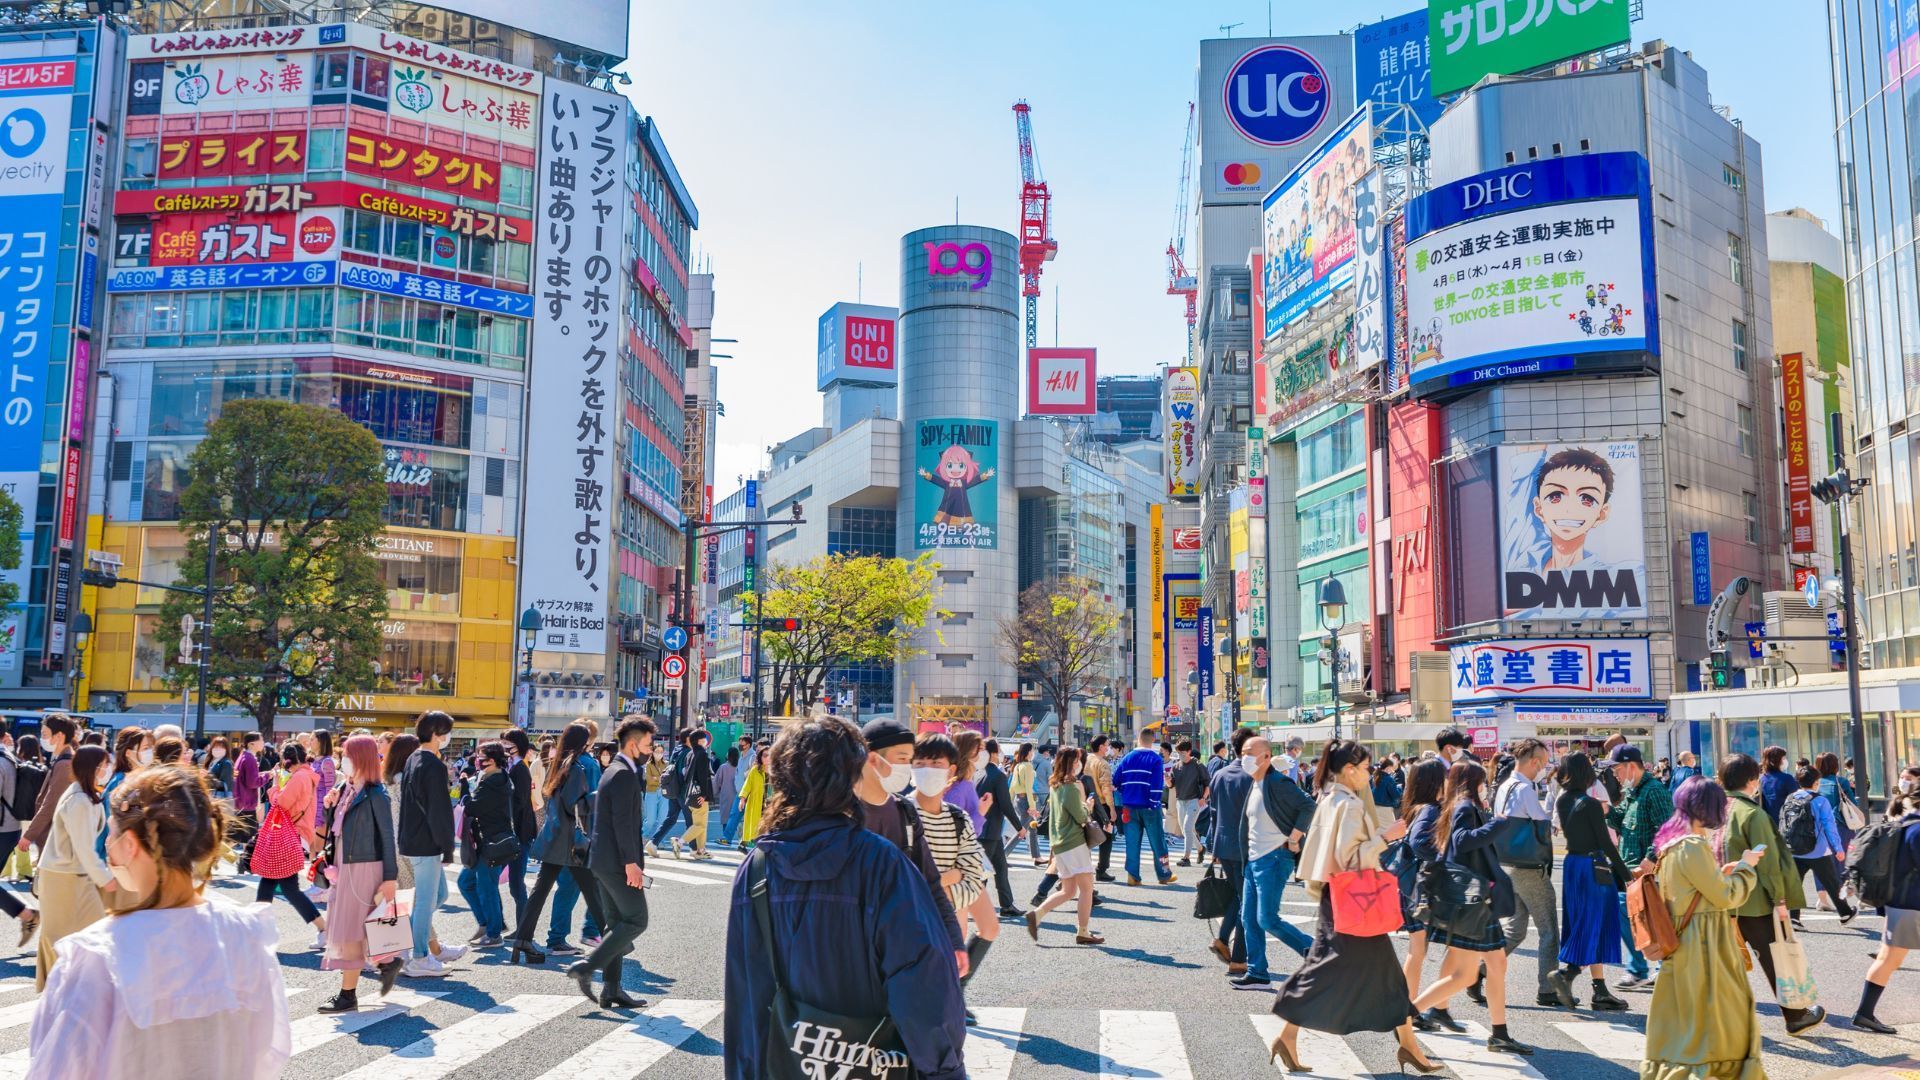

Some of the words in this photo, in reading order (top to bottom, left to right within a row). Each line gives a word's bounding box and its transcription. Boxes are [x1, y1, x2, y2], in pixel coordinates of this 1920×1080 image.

[151, 29, 304, 53] しゃぶしゃぶバイキング
[380, 33, 534, 87] しゃぶしゃぶバイキング
[133, 78, 160, 98] 9F
[216, 63, 303, 96] しゃぶ葉
[441, 84, 531, 131] しゃぶ葉
[163, 136, 301, 170] プライス
[347, 135, 496, 191] コンタクト
[243, 185, 314, 213] ガスト
[1462, 171, 1533, 210] DHC
[451, 209, 517, 242] ガスト
[544, 92, 579, 336] いい曲あります。
[118, 233, 151, 255] 7F
[158, 230, 197, 248] Café
[158, 248, 195, 259] レストラン
[199, 223, 287, 262] ガスト
[304, 233, 332, 244] ガスト
[1415, 217, 1616, 273] 春の交通安全運動実施中
[115, 270, 156, 286] AEON
[170, 267, 297, 287] 英会話イーオン
[305, 267, 326, 281] 6F
[924, 242, 993, 291] 109
[1355, 180, 1382, 358] もんじゃ
[347, 266, 393, 289] AEON
[404, 277, 531, 312] 英会話イーオン
[1434, 271, 1586, 311] 世界一の交通安全都市
[1449, 293, 1563, 325] TOKYOを目指して
[4, 231, 46, 426] コンタクトの
[852, 323, 886, 342] UNI
[574, 104, 619, 593] ブラジャーのホックを外す歌より、
[851, 343, 888, 364] QLO
[1046, 370, 1080, 392] H&M
[1473, 368, 1496, 380] DHC
[1497, 361, 1540, 376] Channel
[1787, 359, 1804, 467] クスリのことなら
[1791, 475, 1812, 543] 三千里
[961, 537, 976, 546] ON
[978, 539, 992, 547] AIR
[1153, 558, 1161, 602] Matsumoto
[1505, 569, 1642, 609] DMM
[537, 599, 593, 612] サブスク解禁
[545, 615, 569, 628] Hair
[570, 615, 579, 629] is
[580, 617, 604, 631] Bad
[1202, 616, 1210, 647] MIZUHO
[1458, 650, 1632, 689] 大盛堂書店
[1617, 686, 1642, 694] TAISEIDO
[790, 1020, 908, 1076] Human
